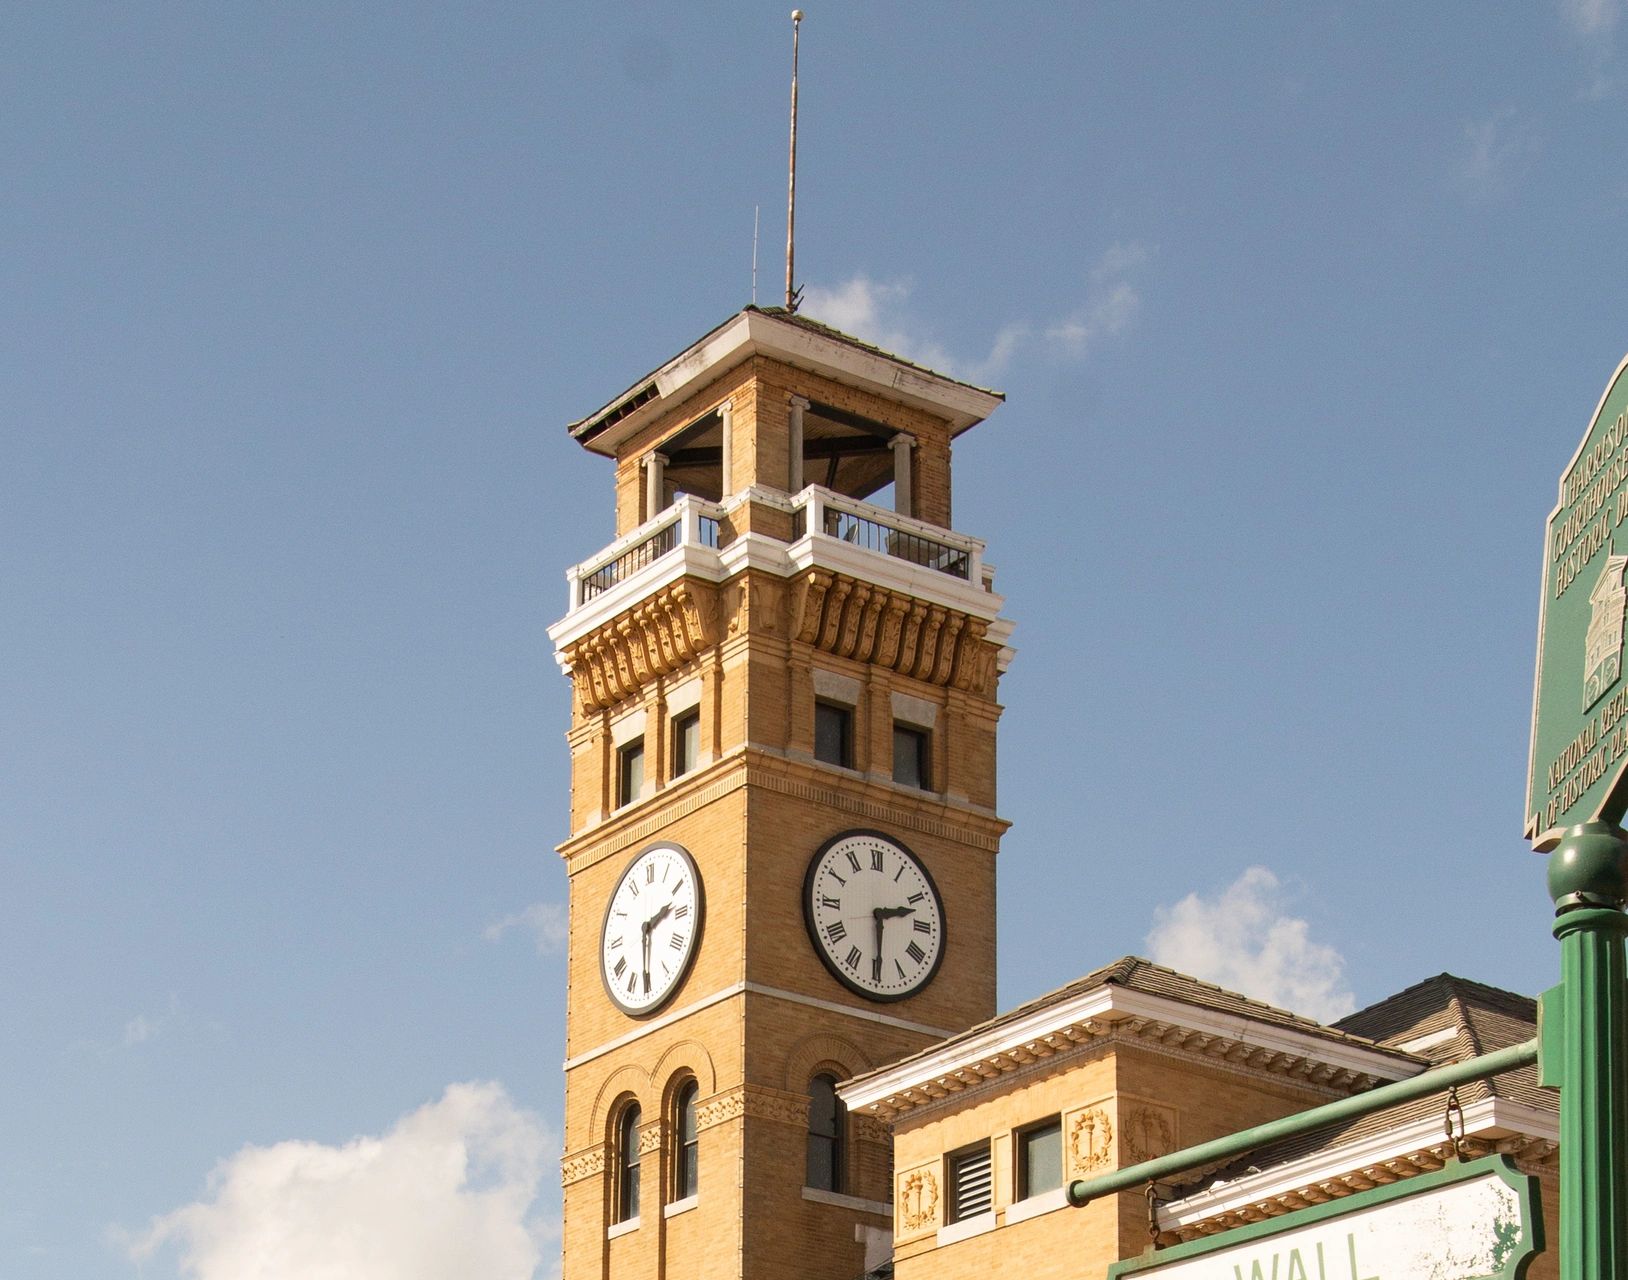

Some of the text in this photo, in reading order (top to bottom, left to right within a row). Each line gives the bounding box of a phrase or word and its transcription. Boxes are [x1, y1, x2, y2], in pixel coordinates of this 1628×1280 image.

[1556, 505, 1613, 600] HISTORIC
[1546, 793, 1560, 829] OF
[1561, 742, 1608, 815] HISTORIC
[1547, 683, 1628, 794] NATIONAL REGI
